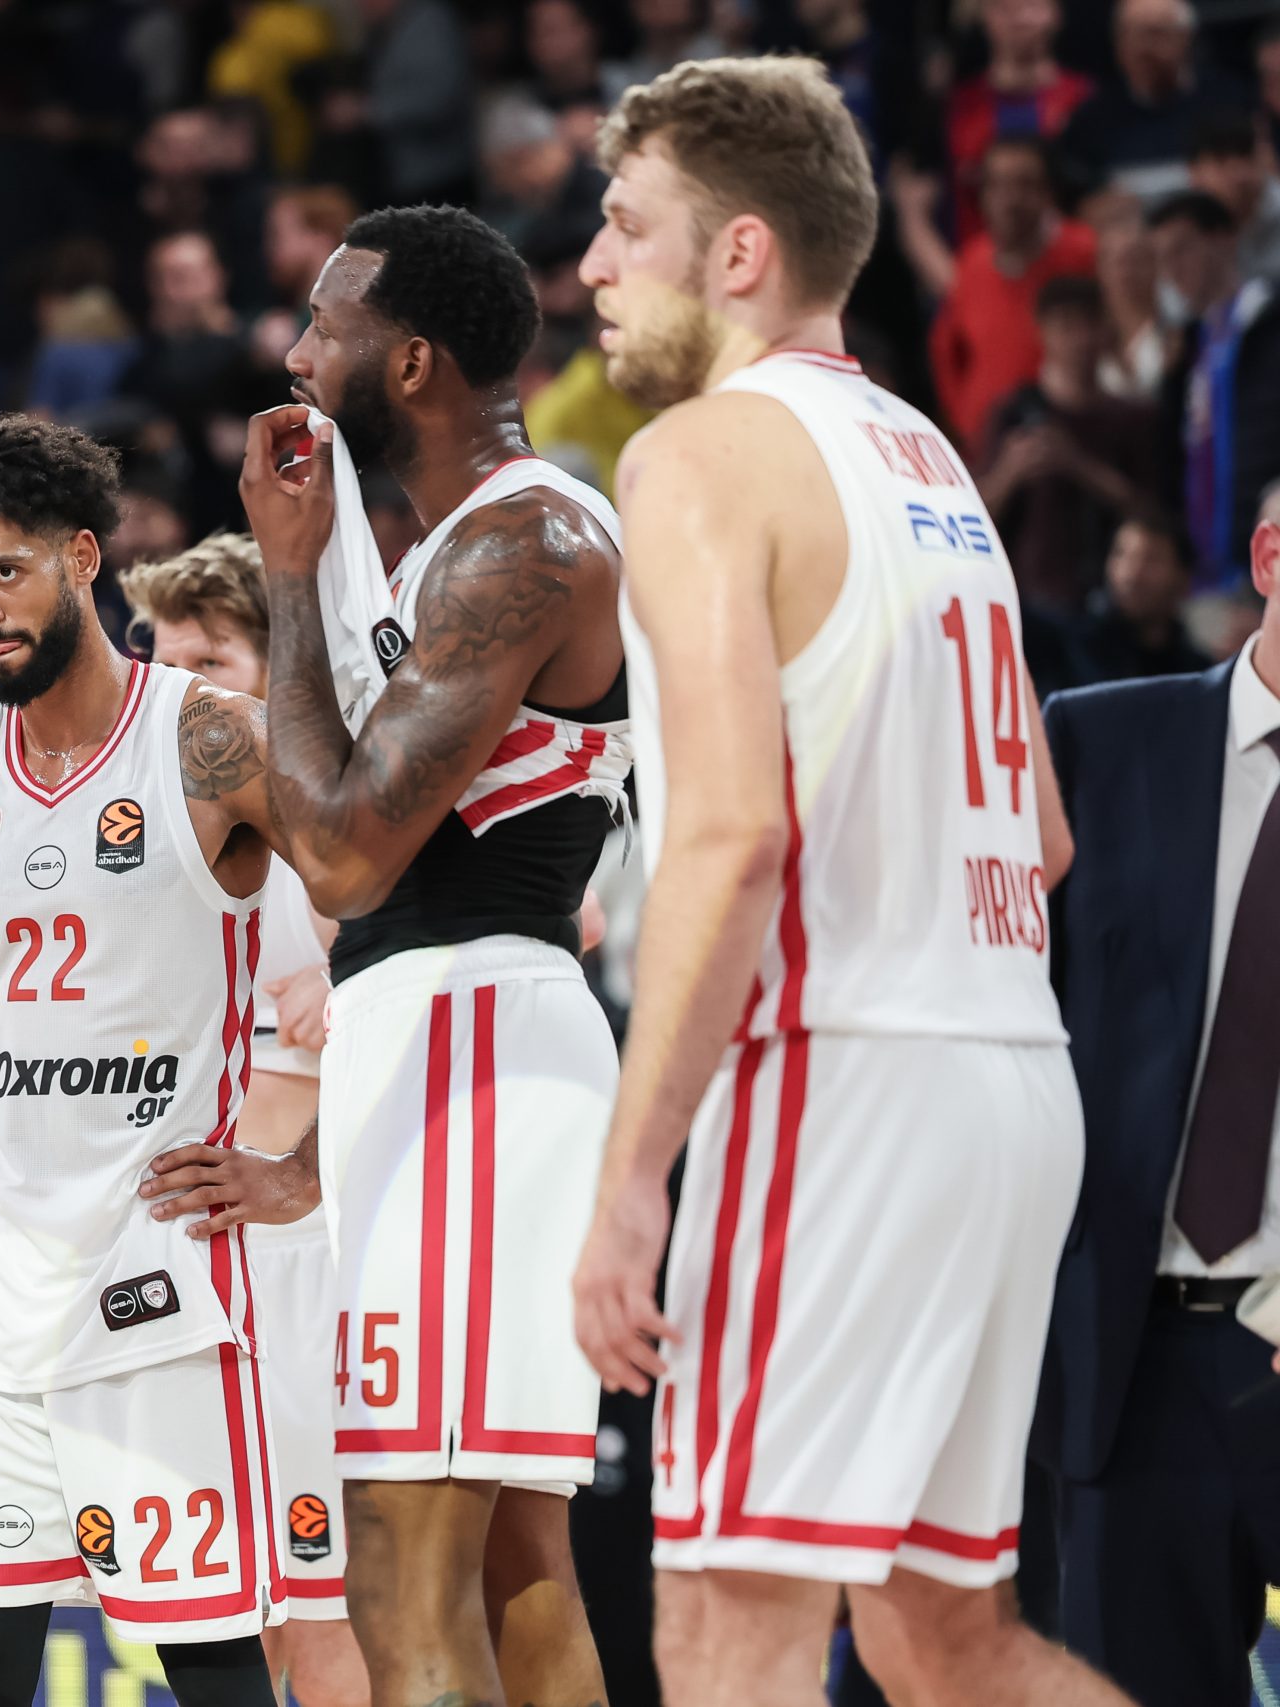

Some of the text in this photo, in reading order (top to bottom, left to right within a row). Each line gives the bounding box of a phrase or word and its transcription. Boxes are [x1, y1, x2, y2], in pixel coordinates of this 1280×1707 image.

[940, 595, 1027, 815] 14
[28, 861, 63, 871] GSA
[97, 855, 141, 865] abu dhabi
[5, 913, 87, 1002] 22
[126, 1095, 174, 1128] .gr
[334, 1311, 400, 1408] 45
[133, 1488, 230, 1583] 22
